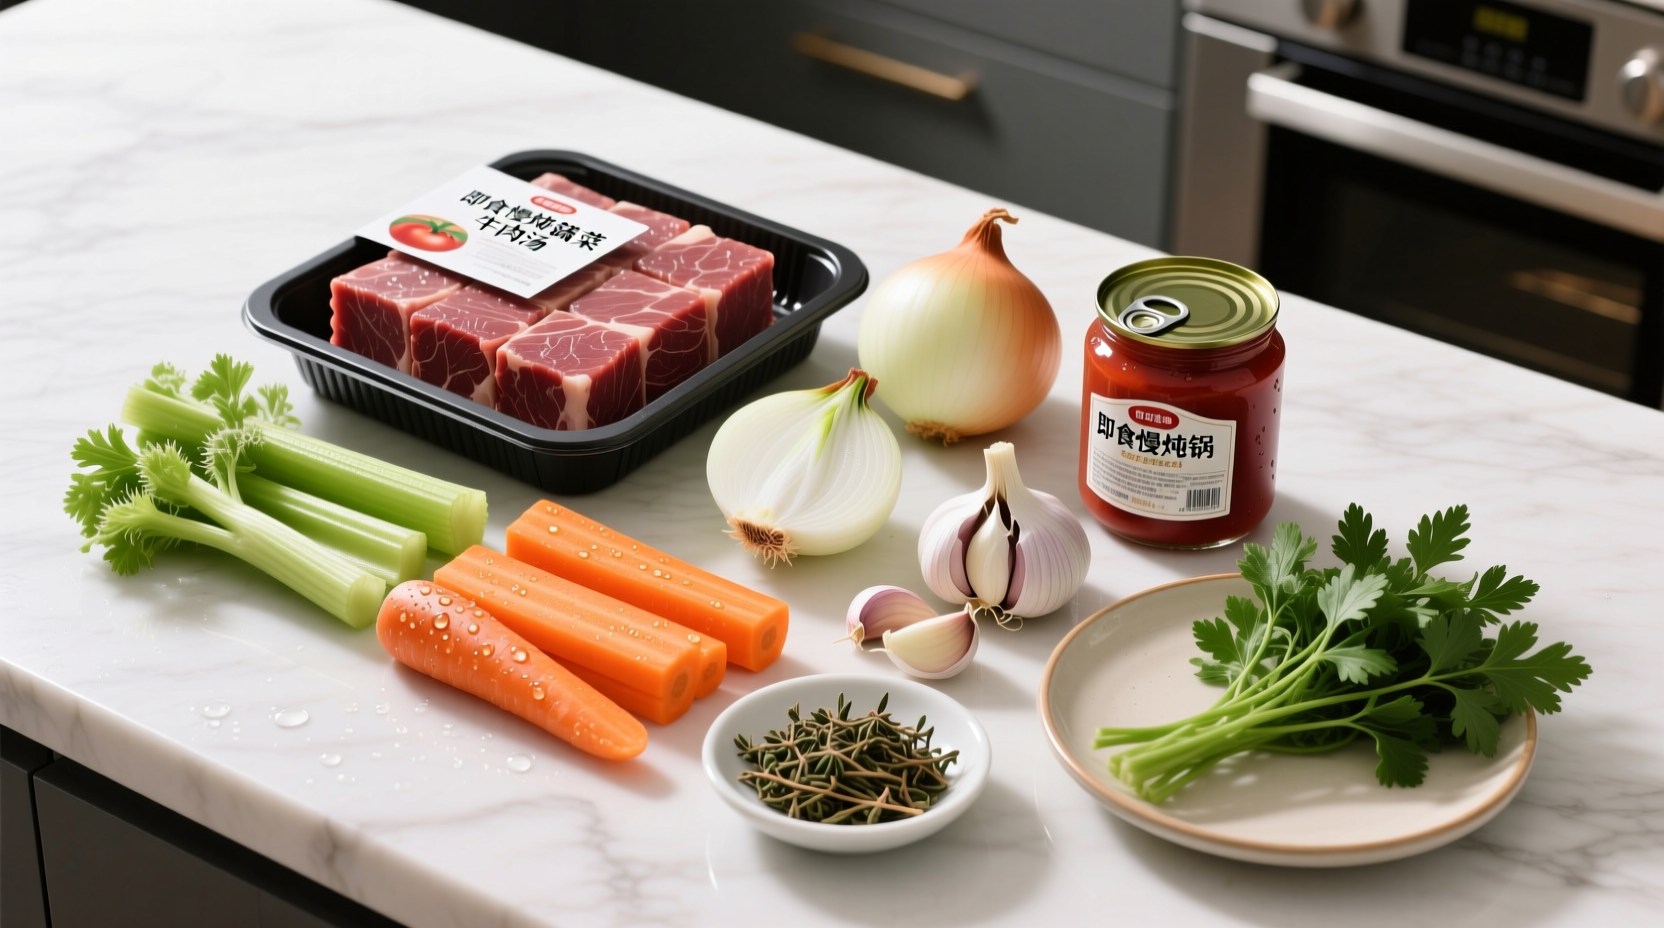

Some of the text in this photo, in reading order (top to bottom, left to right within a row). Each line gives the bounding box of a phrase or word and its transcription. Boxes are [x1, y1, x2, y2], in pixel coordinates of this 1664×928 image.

[475, 215, 549, 251] 牛肉汤
[1097, 411, 1214, 459] 即食慢炖锅
